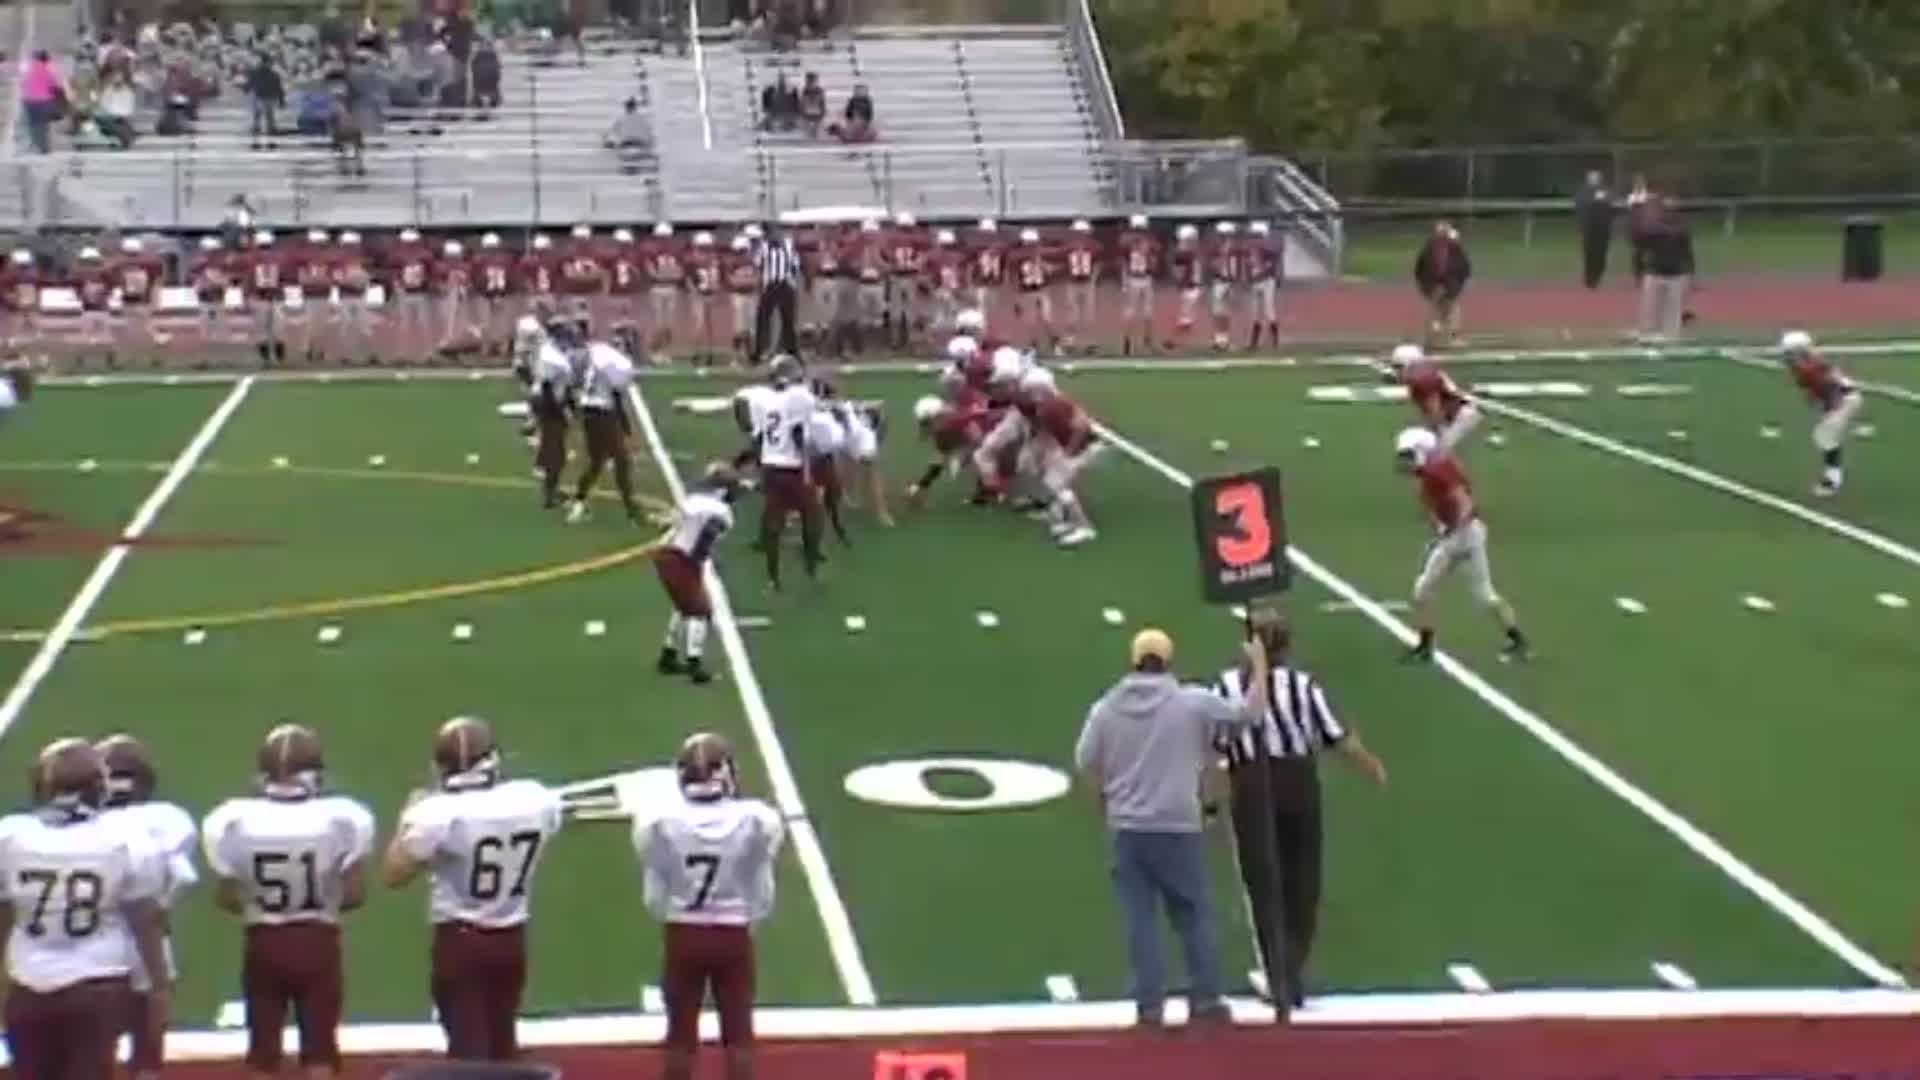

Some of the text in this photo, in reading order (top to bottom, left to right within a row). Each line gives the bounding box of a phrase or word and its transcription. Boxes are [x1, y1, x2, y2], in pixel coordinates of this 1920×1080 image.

[1215, 481, 1272, 567] 3
[844, 757, 1071, 810] 0
[252, 851, 324, 912] 51
[469, 831, 542, 899] 67
[684, 854, 722, 912] 7
[18, 869, 104, 937] 78
